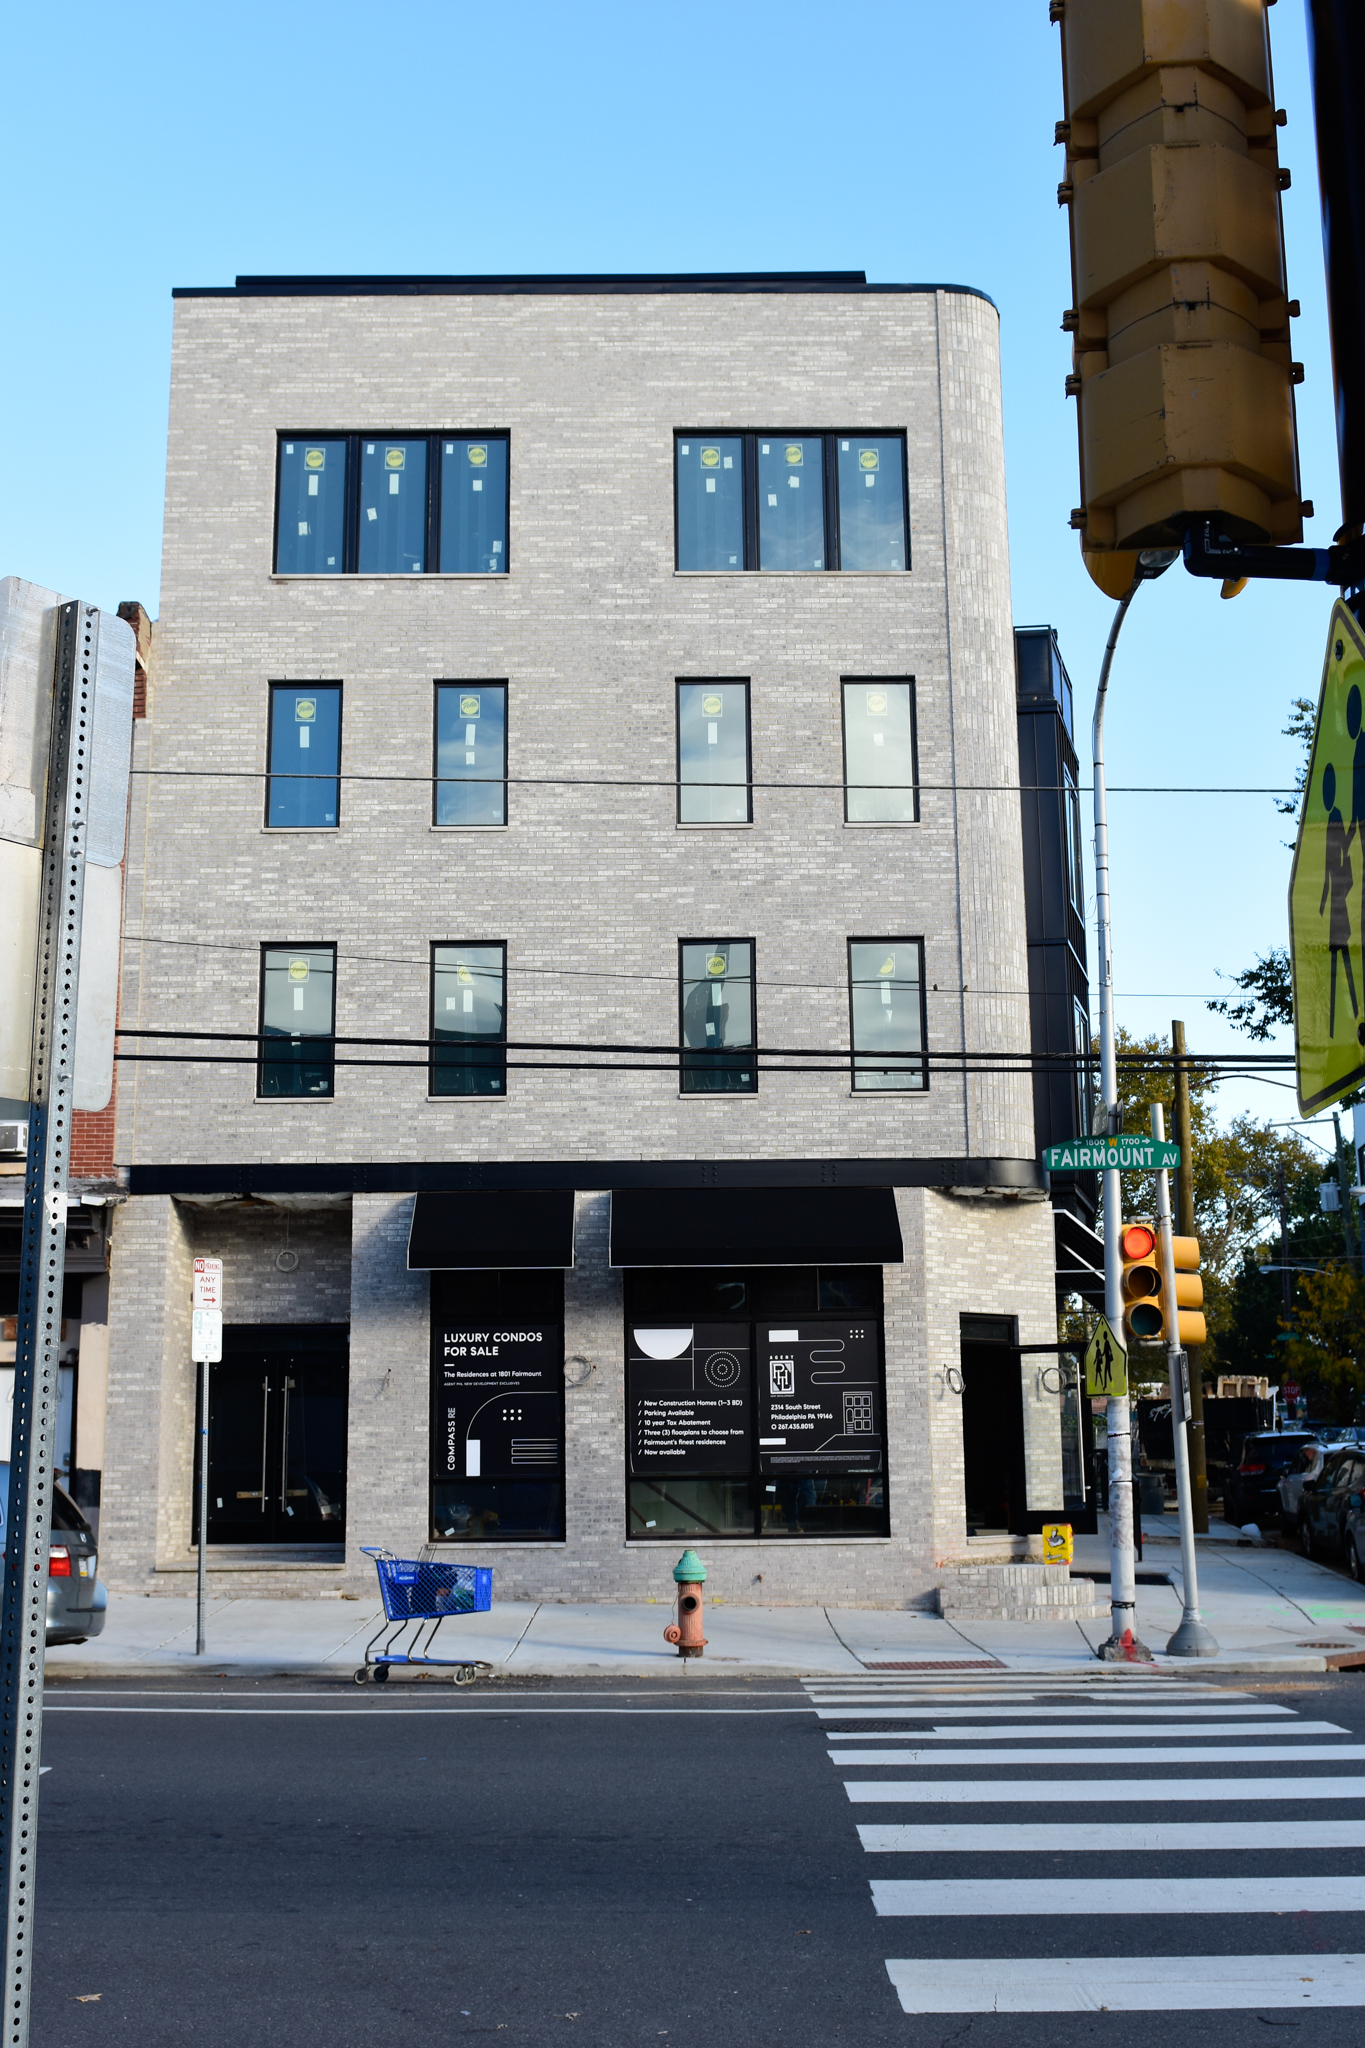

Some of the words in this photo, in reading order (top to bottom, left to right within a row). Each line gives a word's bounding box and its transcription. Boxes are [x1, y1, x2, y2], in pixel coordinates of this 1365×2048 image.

[1108, 1138, 1118, 1147] W
[1051, 1148, 1154, 1166] FAIRMOUNT
[1162, 1153, 1177, 1165] AV
[195, 1260, 204, 1272] NO
[196, 1314, 201, 1327] 2
[444, 1333, 489, 1343] LUXURY
[493, 1332, 542, 1342] CONDOS
[444, 1347, 467, 1356] FOR
[470, 1346, 499, 1356] SALE
[448, 1408, 455, 1418] RE
[447, 1421, 456, 1470] COMPASS
